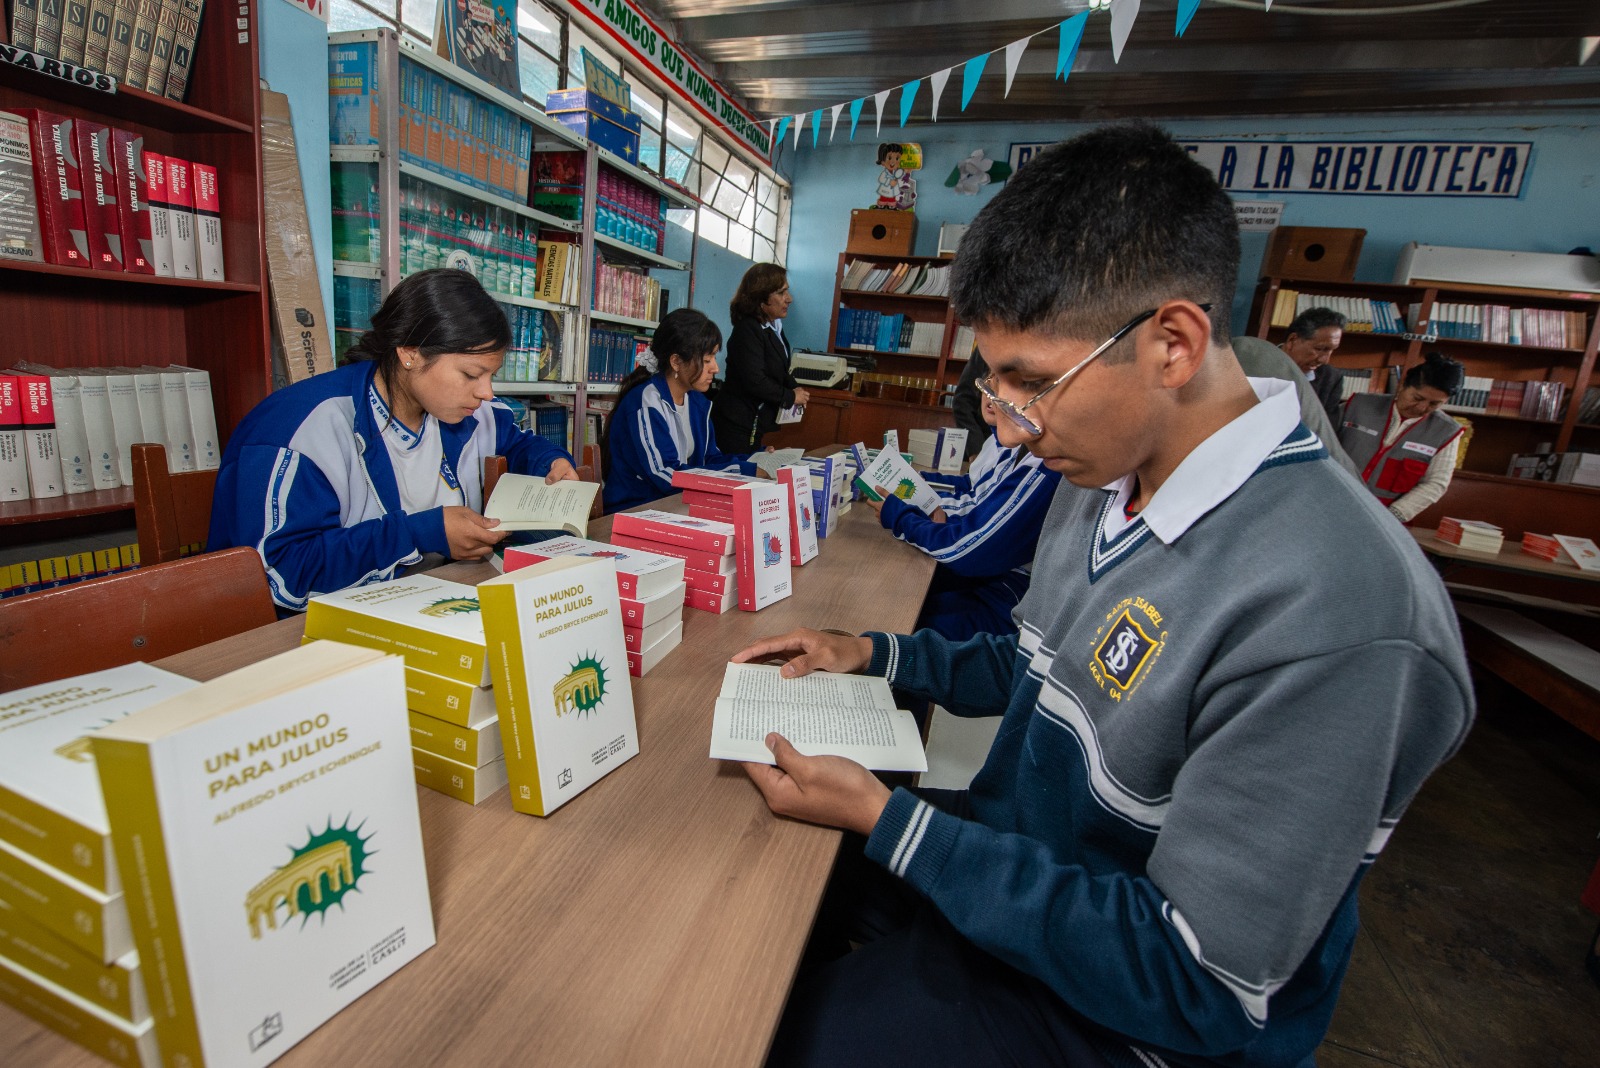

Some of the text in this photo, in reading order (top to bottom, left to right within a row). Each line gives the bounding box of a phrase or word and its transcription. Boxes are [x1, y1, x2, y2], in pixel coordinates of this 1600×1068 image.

[604, 0, 656, 56] AMIGOS
[661, 41, 684, 81] QUE
[686, 67, 717, 113] NUNCA
[1218, 145, 1518, 193] A LA BIBLIOTECA
[2, 382, 13, 406] María
[28, 382, 39, 414] Moliner
[39, 382, 48, 406] María
[376, 406, 399, 433] ISAEL
[534, 584, 584, 609] UN MUNDO
[536, 595, 593, 624] PARA JULIUS
[1133, 596, 1163, 629] ISABEL
[538, 608, 609, 640] ALFREDO BRYCE ECHENIQUE
[204, 713, 330, 775] UN MUNDO
[208, 727, 349, 799] PARA JULIUS
[214, 741, 382, 825] ALFREDO BRYCE ECHENIQUE
